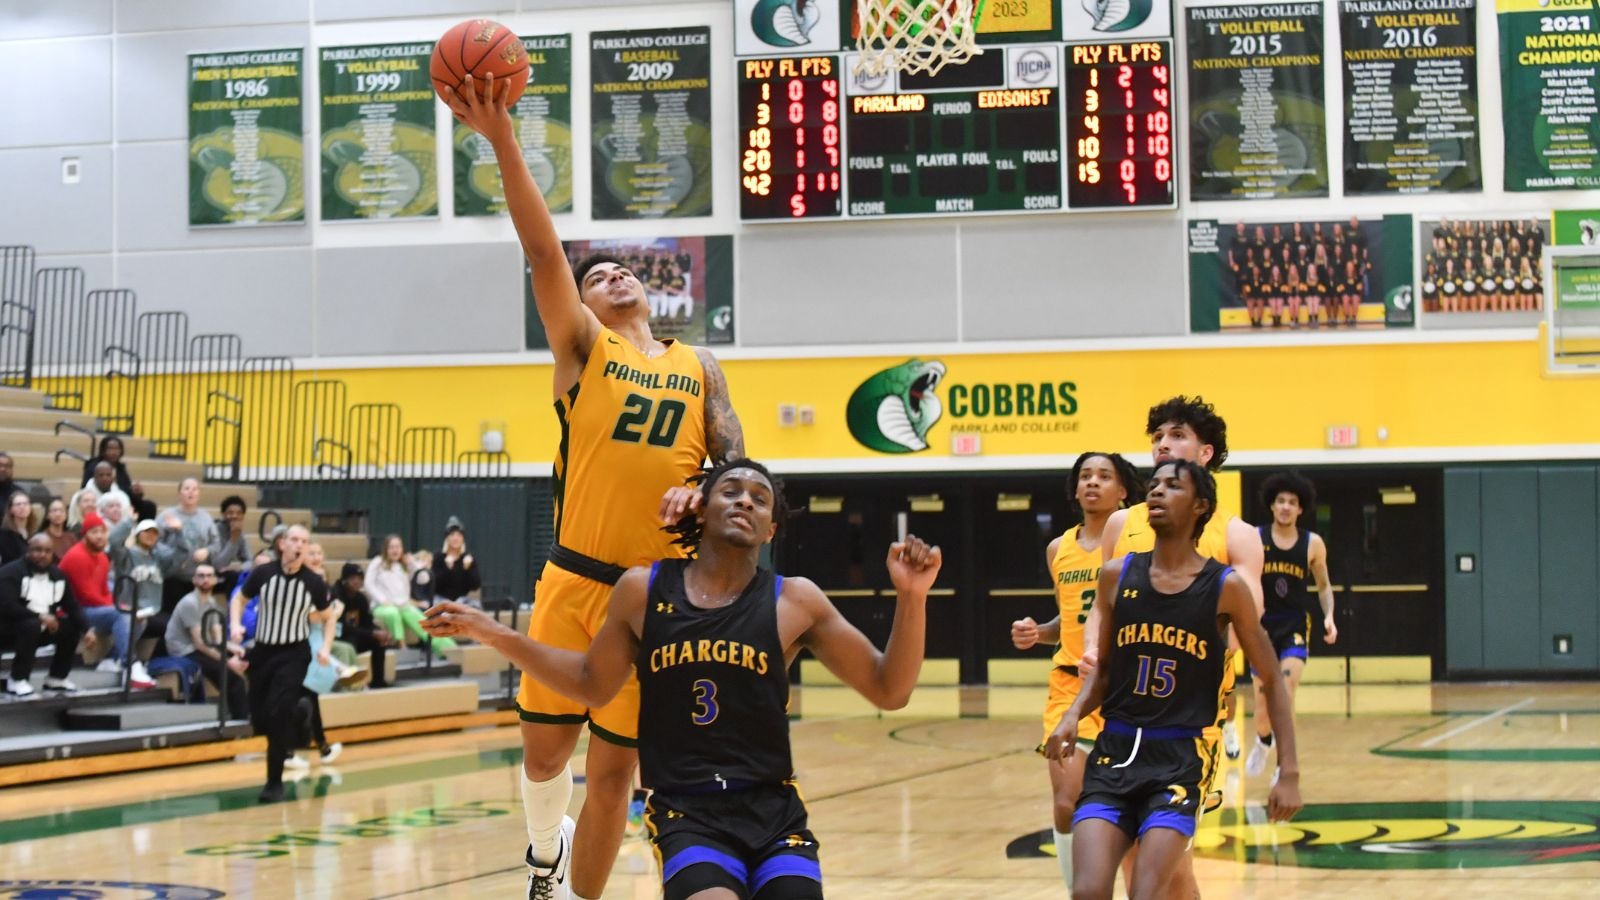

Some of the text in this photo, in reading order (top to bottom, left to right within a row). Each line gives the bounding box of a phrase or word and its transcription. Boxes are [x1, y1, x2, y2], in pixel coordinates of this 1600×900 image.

[993, 2, 1028, 18] 2023
[1191, 4, 1319, 20] PARKLAND COLLEGE
[1345, 0, 1473, 13] PARKLAND COLLEGE
[1220, 20, 1305, 35] VOLLEYBALL
[1375, 13, 1460, 28] VOLLEYBALL
[1540, 16, 1590, 32] 2021
[593, 34, 708, 49] PARKLAND COLLEGE
[1230, 34, 1282, 56] 2015
[1383, 27, 1437, 48] 2016
[1525, 33, 1600, 48] NATIONA
[192, 51, 299, 67] PARKLAND COLLEGE
[323, 44, 433, 60] PARKLAND COLLEGE
[623, 50, 680, 63] BASEBALL
[1074, 43, 1161, 64] PLY FL PTS
[1344, 46, 1475, 60] NATIONAL CHAMPIONS
[347, 59, 419, 74] VOLLEYBALL
[627, 62, 674, 81] 2009
[746, 58, 831, 78] PLY FL PTS
[1193, 55, 1320, 70] NATIONAL CHAMPIONS
[231, 65, 298, 79] BASKETBALL
[1090, 65, 1167, 87] 1 2 4
[225, 78, 269, 99] 1986
[357, 72, 401, 92] 1999
[593, 78, 708, 93] NATIONAL CHAMPIONS
[762, 80, 837, 101] 1 0 4
[192, 97, 299, 112] NATIONAL CHAMPIONS
[324, 91, 433, 105] NATIONAL CHAMPIONS
[854, 94, 925, 113] PARKLAND
[978, 89, 1051, 108] EDISONST
[1086, 88, 1168, 111] 3 1 4
[758, 100, 837, 125] 3 0 8
[933, 102, 971, 115] PERIOD
[1085, 111, 1168, 134] 4 1 10
[750, 124, 838, 148] 10 1 0
[1078, 134, 1169, 159] 10 1 10
[743, 148, 838, 172] 20 1 7
[850, 157, 884, 169] FOULS
[917, 153, 989, 166] PLAYER FOUL
[1023, 150, 1058, 163] FOULS
[1079, 158, 1169, 184] 15 0 0
[743, 172, 839, 196] 42 1 11
[1526, 177, 1575, 187] PARKLAND
[1122, 183, 1136, 203] 7
[790, 194, 805, 216] 5
[851, 201, 885, 215] SCORE
[936, 199, 973, 212] MATCH
[1024, 196, 1059, 209] SCORE
[603, 360, 700, 398] PARKLAND
[948, 381, 1078, 418] COBRAS
[611, 393, 687, 448] 20
[950, 421, 1080, 434] PARKLAND COLLEGE
[1265, 562, 1304, 580] HARGERS
[1117, 623, 1208, 661] CHARGERS
[650, 639, 768, 675] CHARGERS
[1133, 654, 1177, 698] 15
[691, 678, 719, 726] 3
